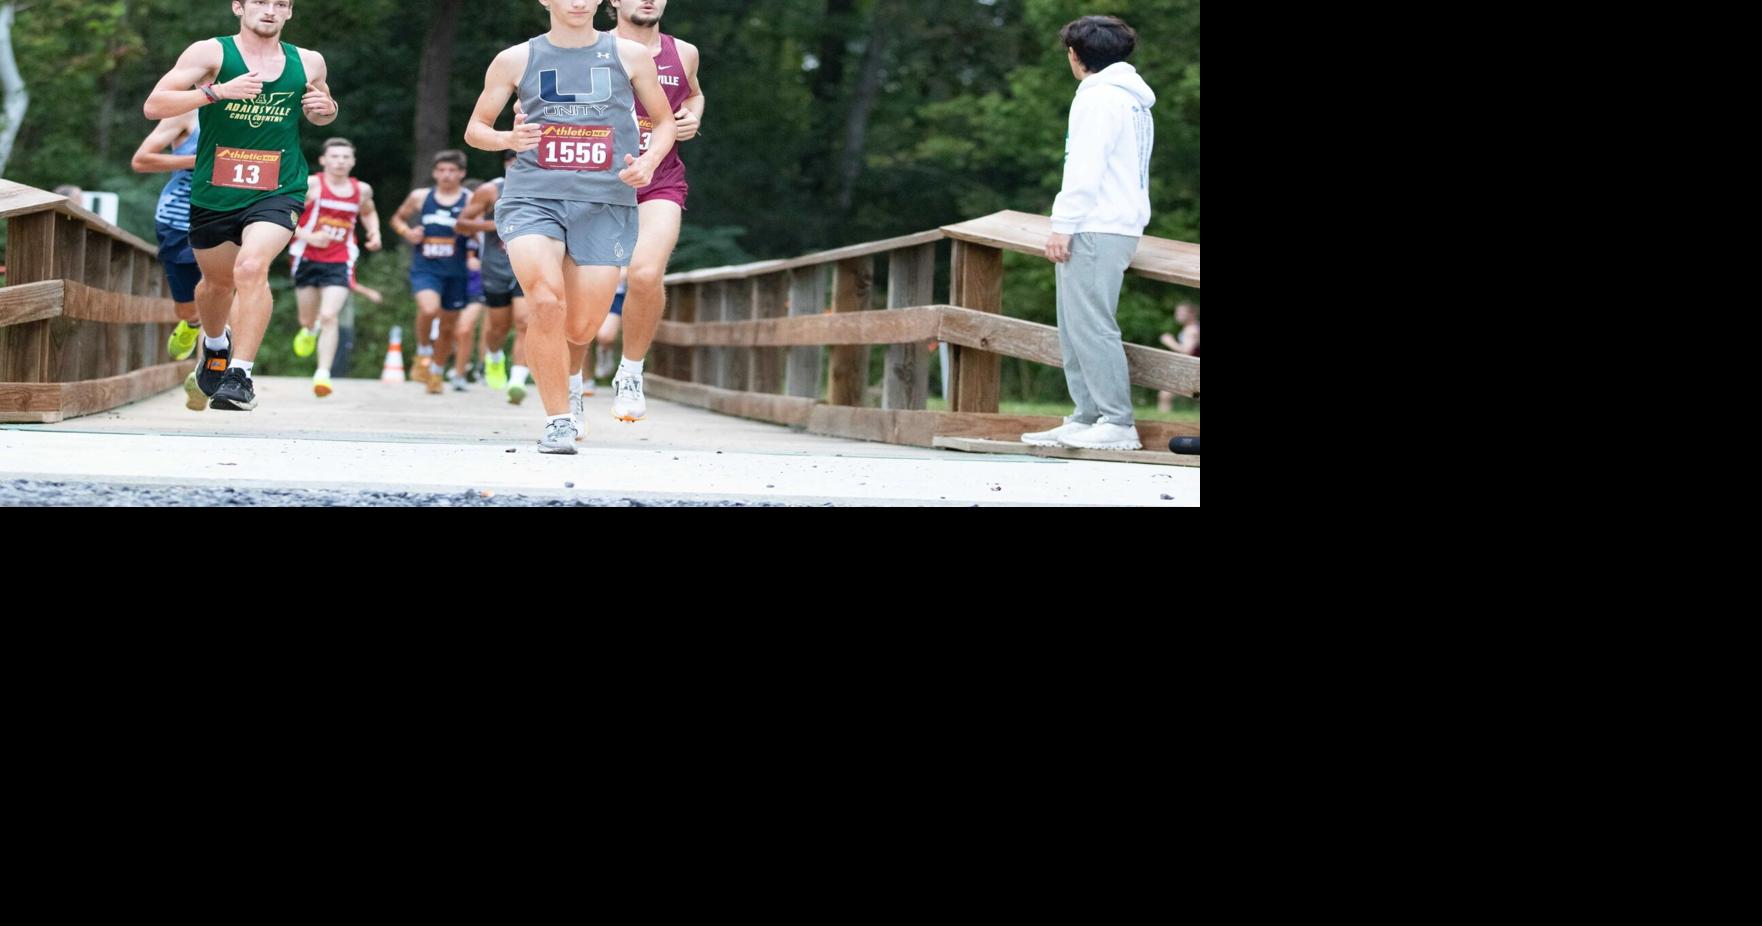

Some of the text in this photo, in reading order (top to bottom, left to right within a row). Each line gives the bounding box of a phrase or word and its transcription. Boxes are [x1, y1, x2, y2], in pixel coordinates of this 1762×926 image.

[224, 102, 291, 116] ADAIRSVILLE
[544, 104, 608, 117] UNITY
[229, 112, 284, 122] CROSS COUNTRY
[545, 141, 606, 164] 1556
[232, 164, 260, 184] 13
